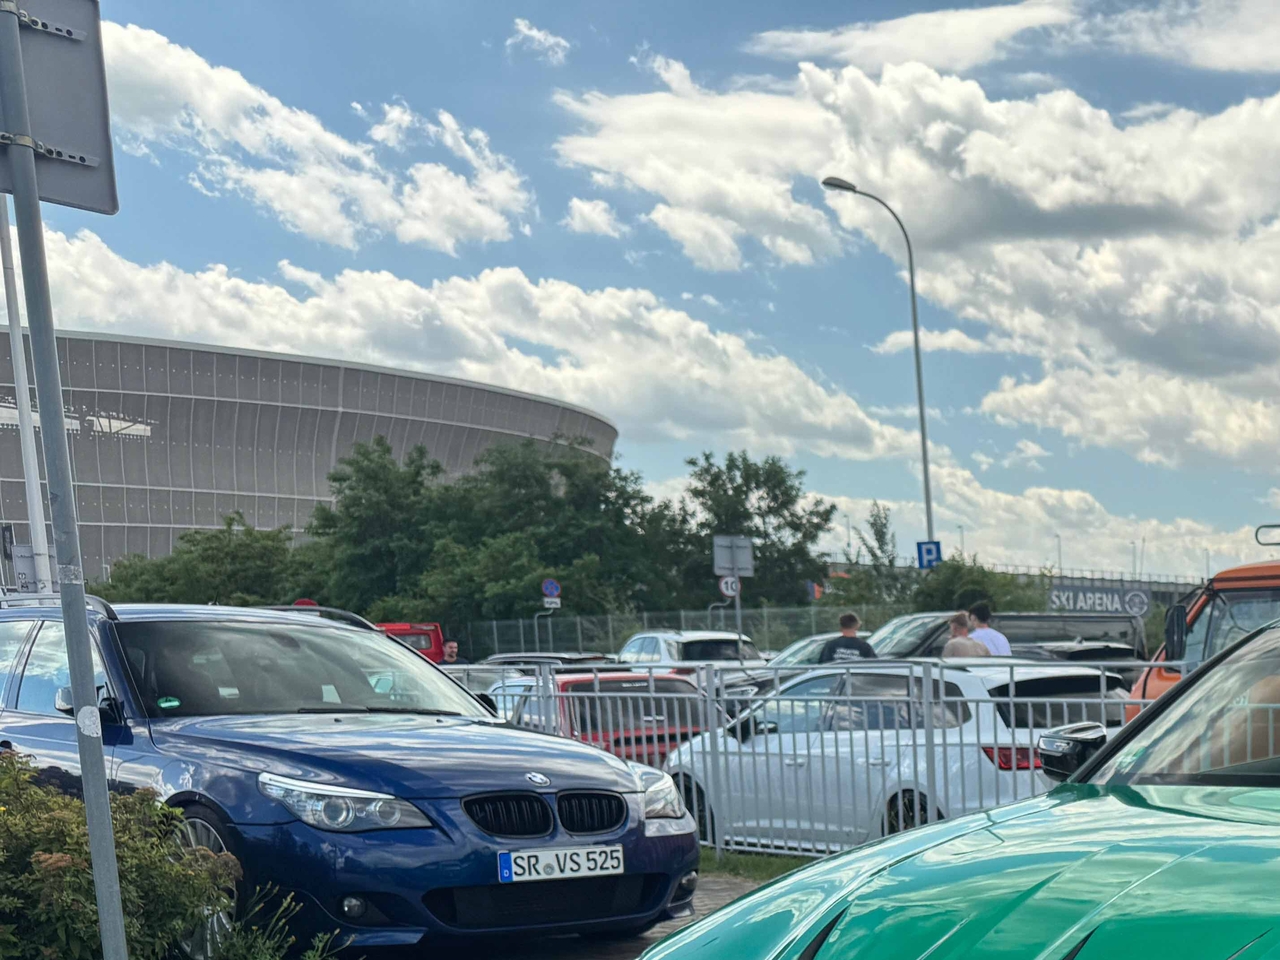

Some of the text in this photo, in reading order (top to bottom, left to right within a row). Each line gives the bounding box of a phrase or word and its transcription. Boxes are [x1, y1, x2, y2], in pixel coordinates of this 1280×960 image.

[921, 544, 937, 567] P
[724, 580, 738, 592] 10
[1051, 590, 1122, 612] SKI ARENA
[513, 850, 621, 876] SR VS 525
